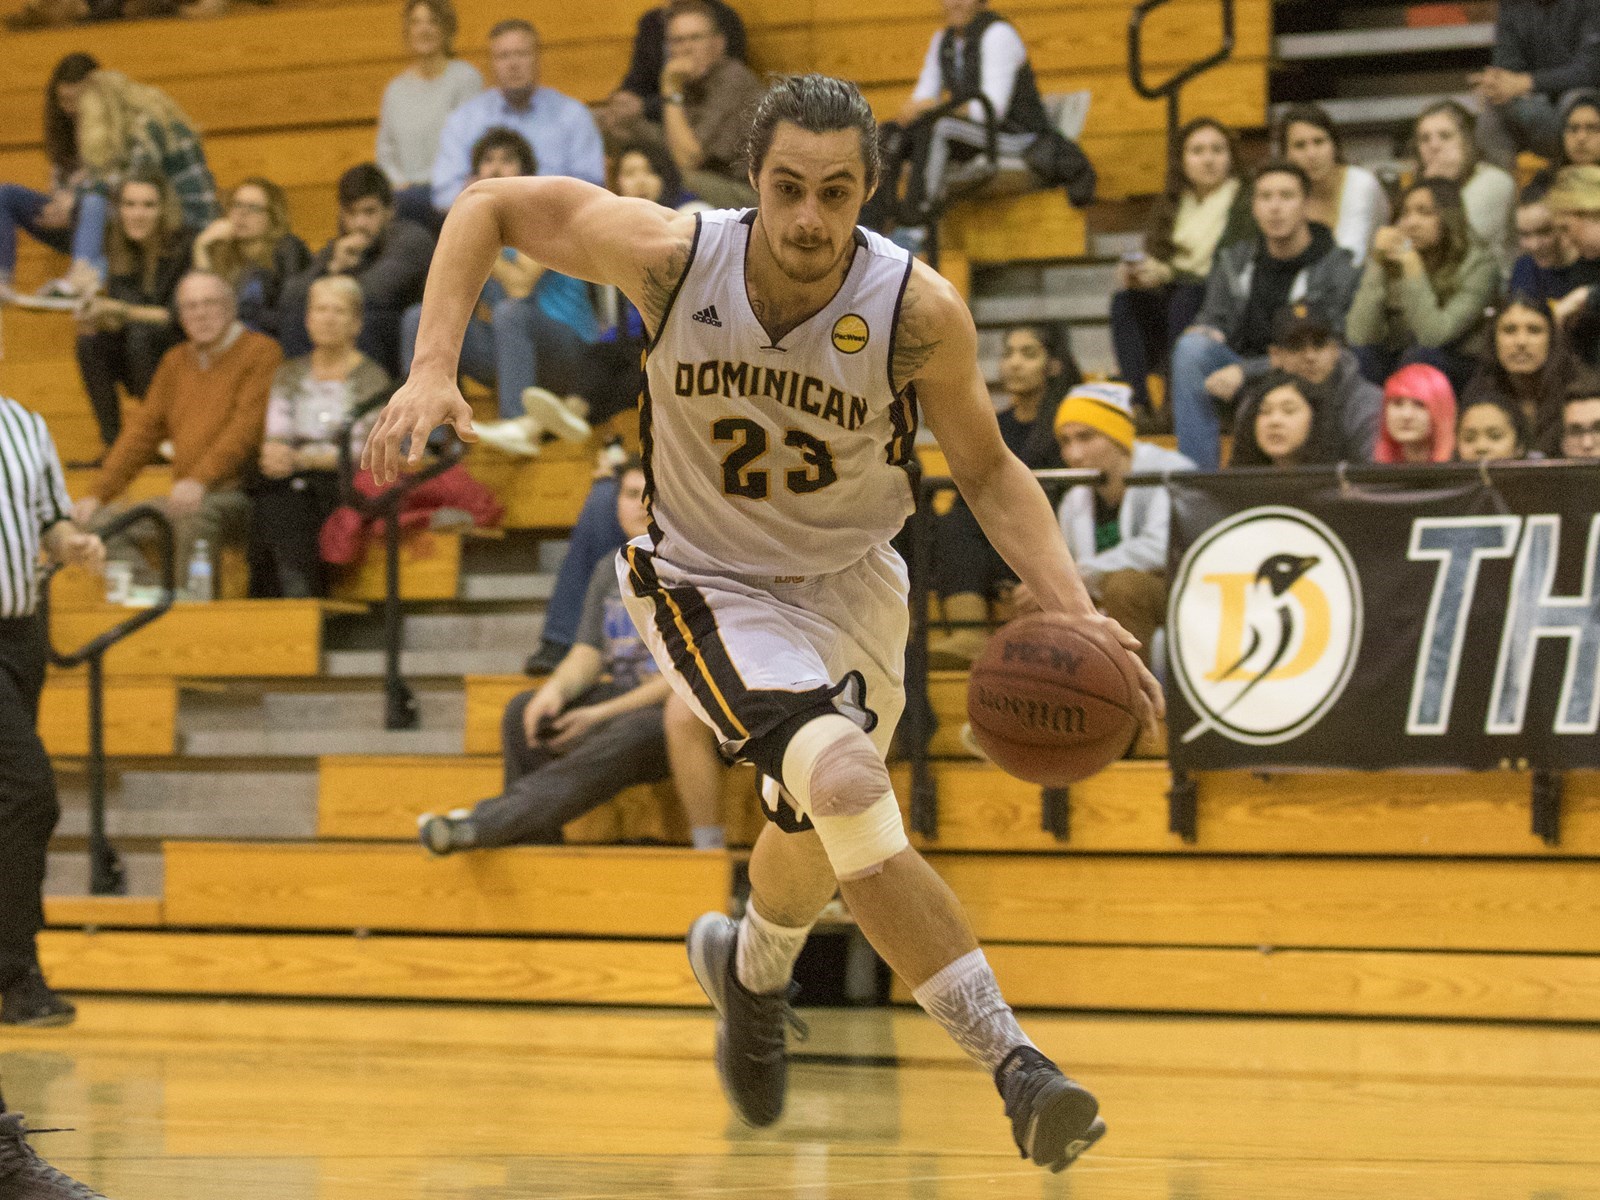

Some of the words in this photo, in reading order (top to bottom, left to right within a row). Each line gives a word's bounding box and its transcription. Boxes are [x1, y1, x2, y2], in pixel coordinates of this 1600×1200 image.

[692, 314, 722, 328] adidas
[834, 333, 866, 343] PacWest
[675, 360, 868, 430] DOMINICAN
[710, 415, 839, 500] 23
